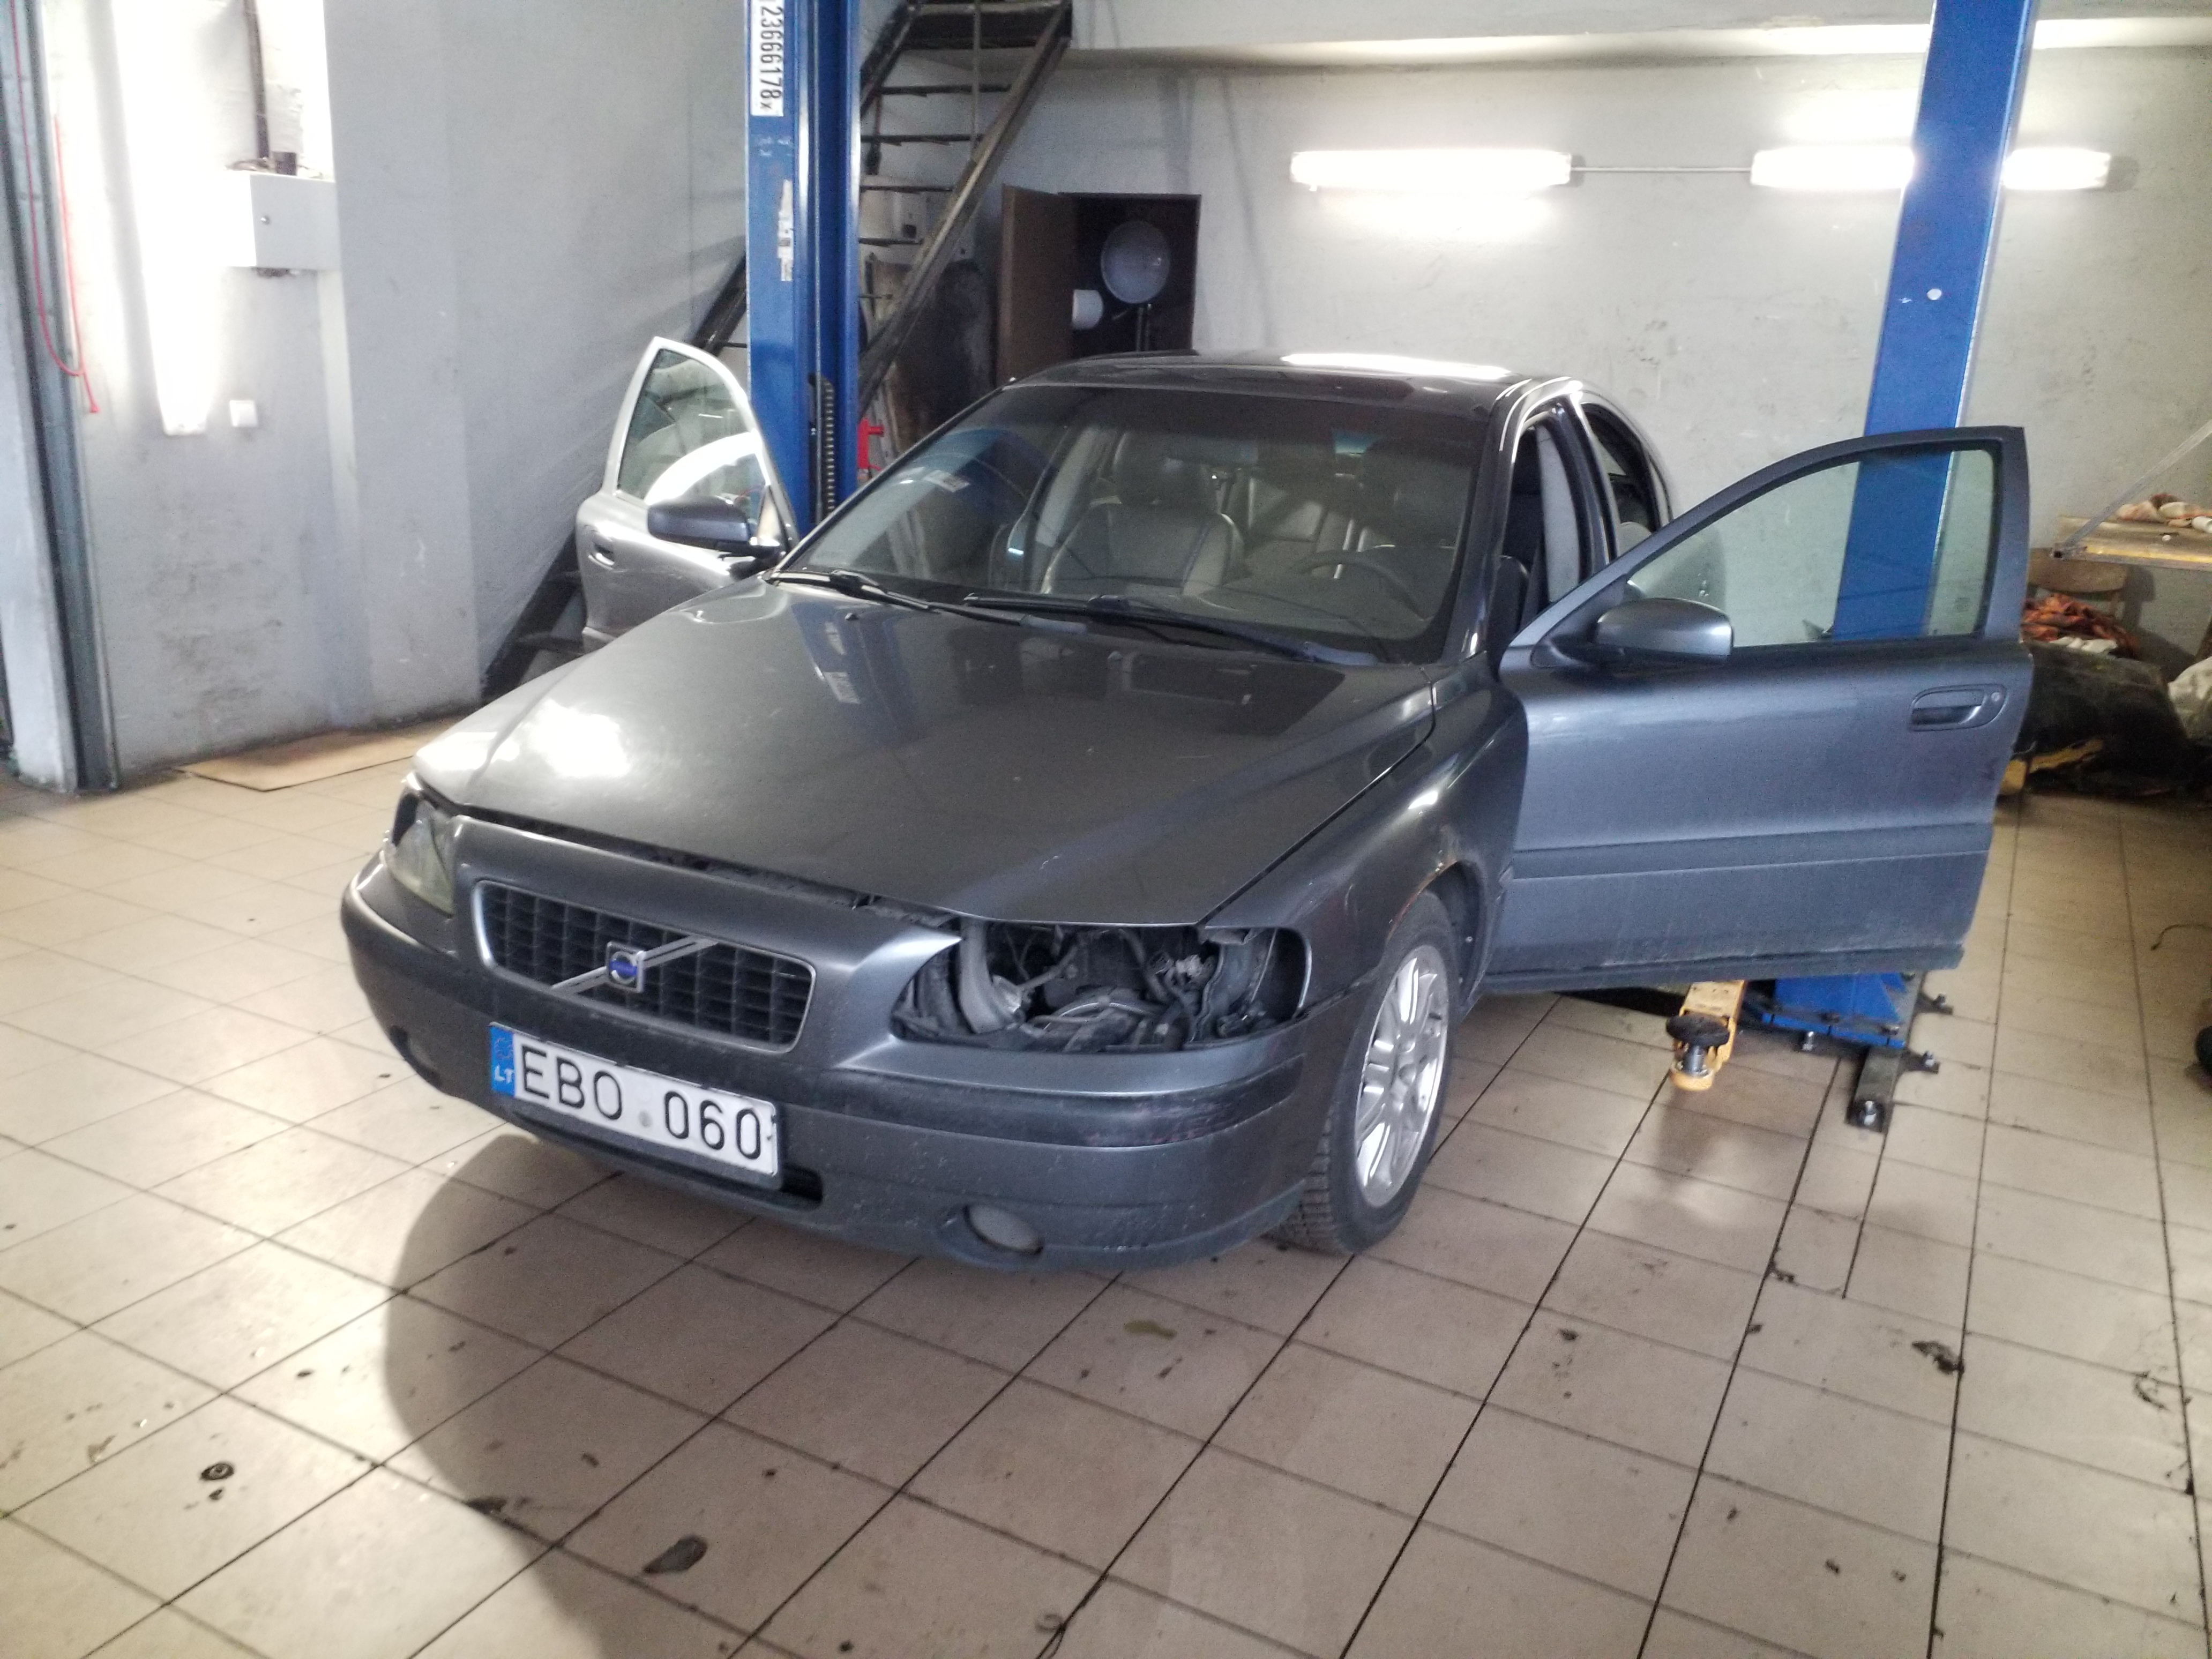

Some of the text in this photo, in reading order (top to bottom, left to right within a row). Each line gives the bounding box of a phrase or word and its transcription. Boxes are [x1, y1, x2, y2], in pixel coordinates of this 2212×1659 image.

[760, 0, 783, 109] 23666178x
[494, 1045, 761, 1160] LT EBO 060
